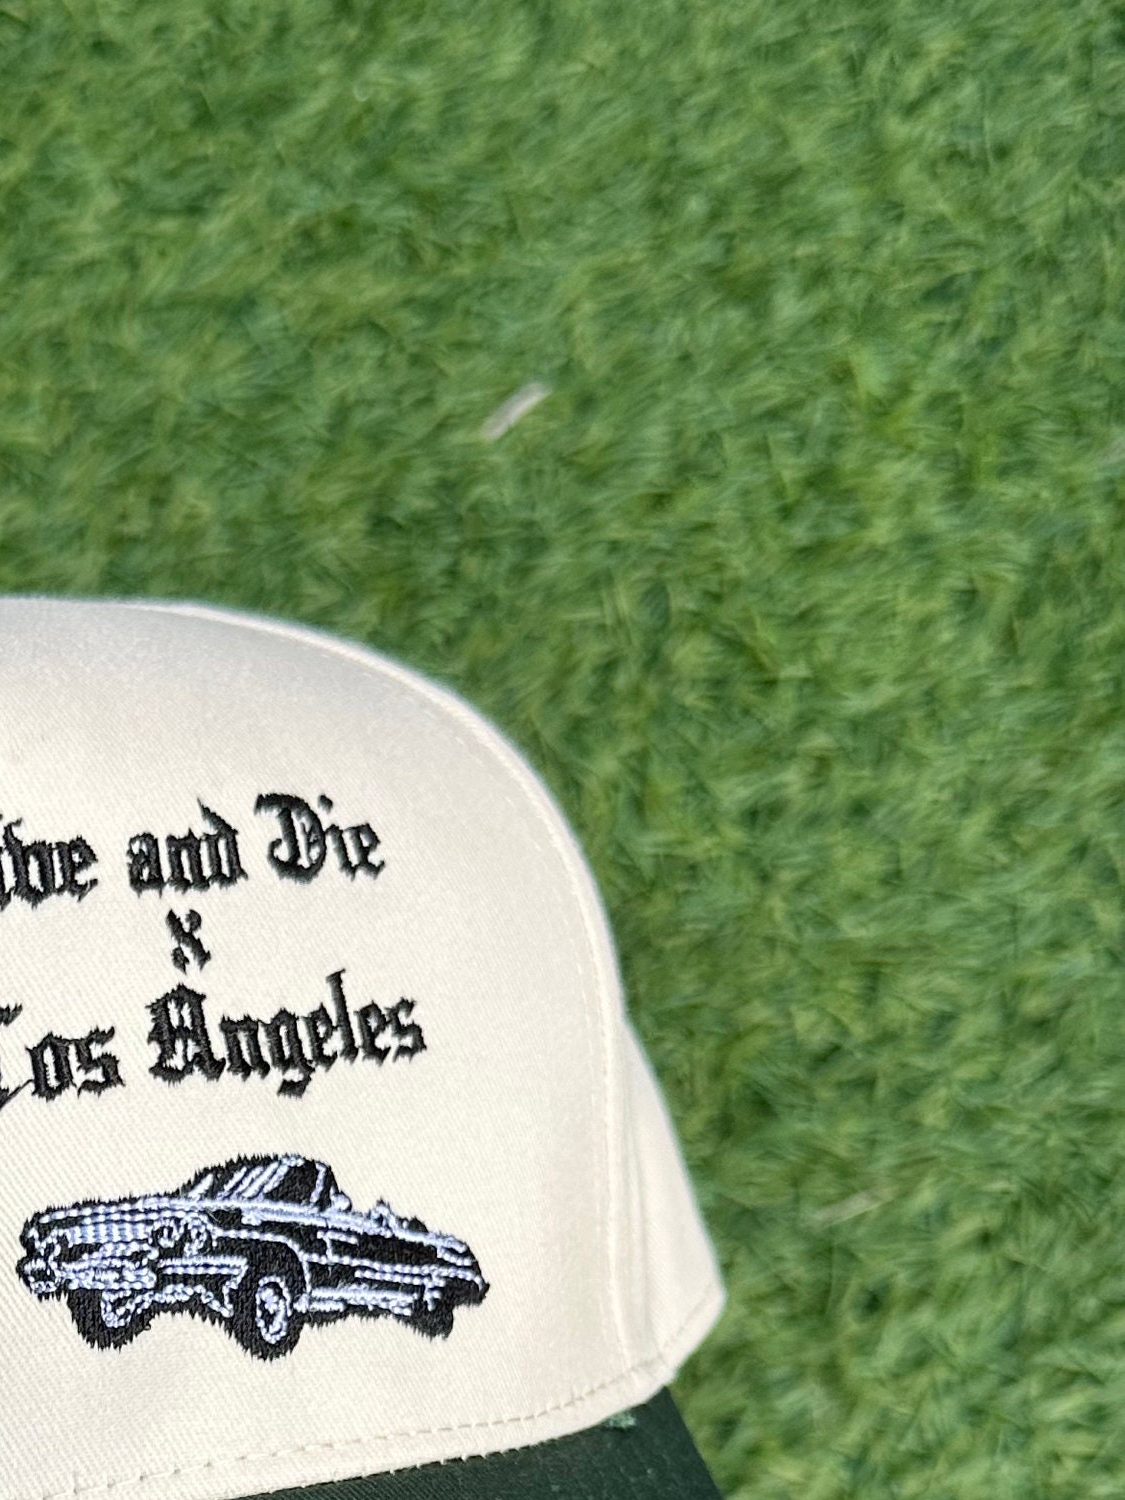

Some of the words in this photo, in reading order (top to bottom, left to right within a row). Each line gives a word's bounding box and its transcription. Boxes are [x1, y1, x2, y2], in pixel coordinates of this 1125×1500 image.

[125, 796, 249, 898] and
[253, 792, 386, 885] Die
[144, 967, 428, 1098] Angeles
